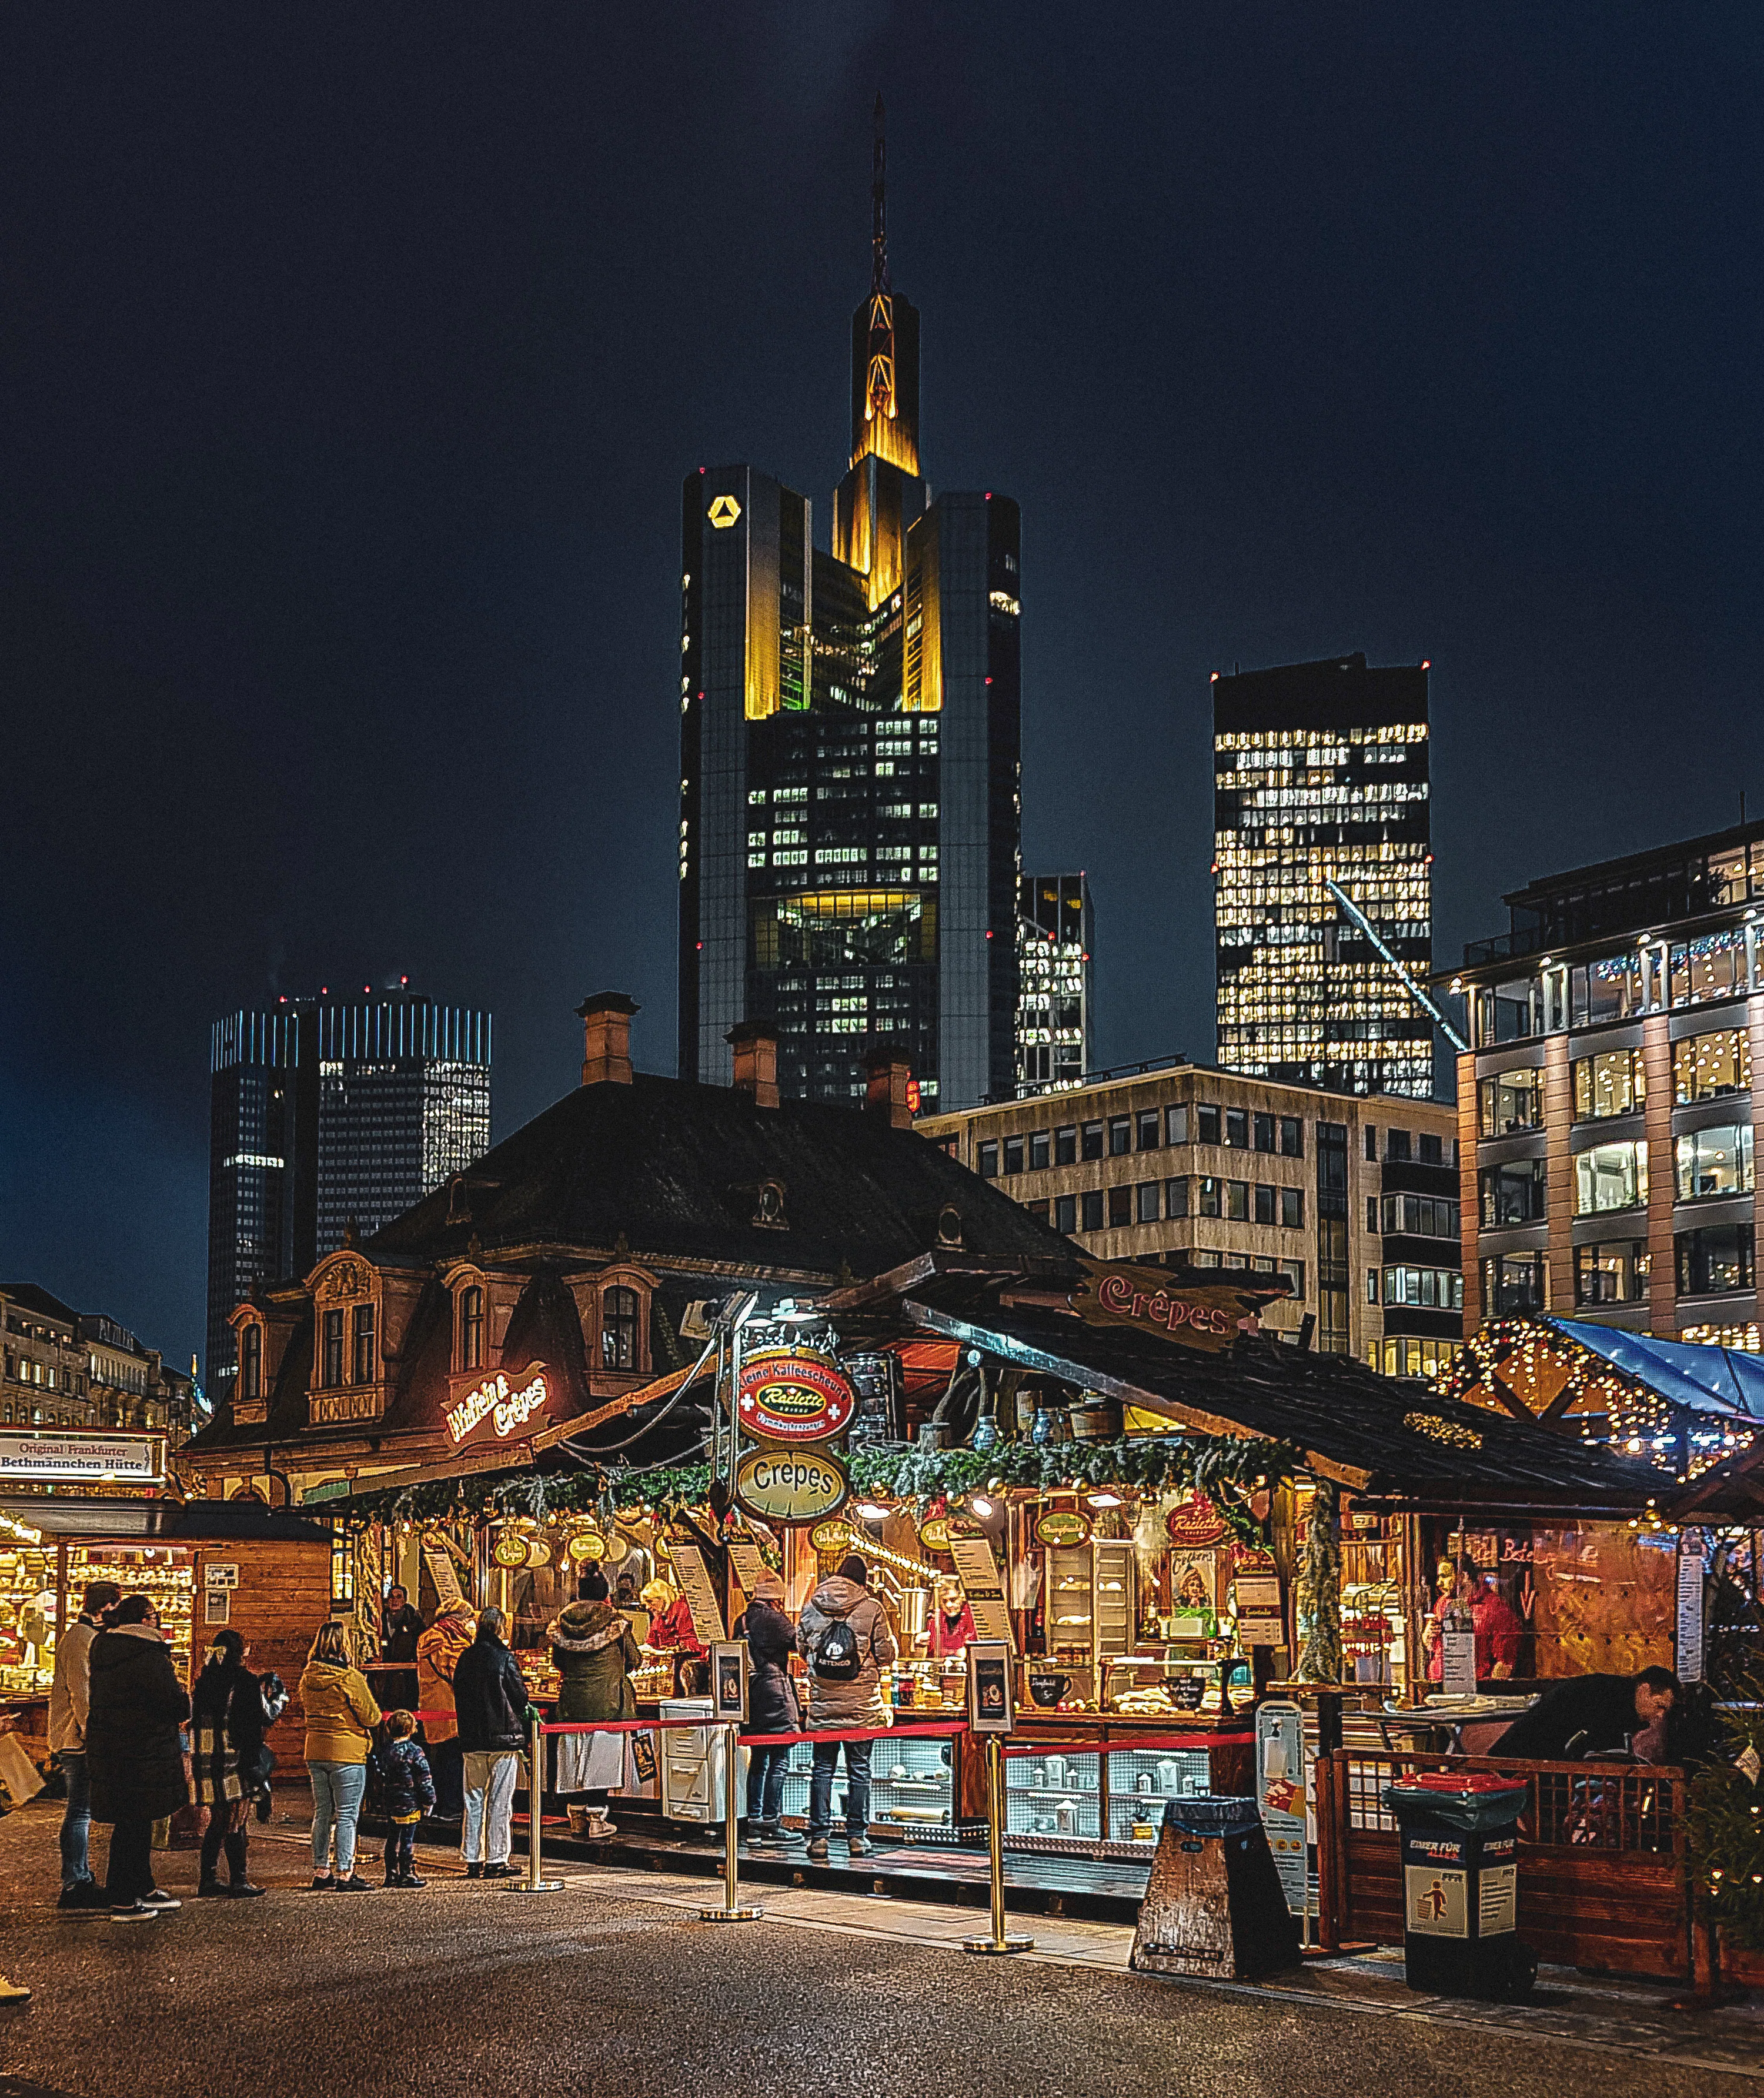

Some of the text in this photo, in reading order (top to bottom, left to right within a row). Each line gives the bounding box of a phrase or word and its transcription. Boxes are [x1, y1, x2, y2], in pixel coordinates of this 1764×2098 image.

[1099, 1275, 1230, 1334] Crêpes
[764, 1387, 824, 1407] Raclette
[19, 1442, 129, 1457] Original Frankfurter
[1, 1456, 142, 1471] Bethmännchen Hütte
